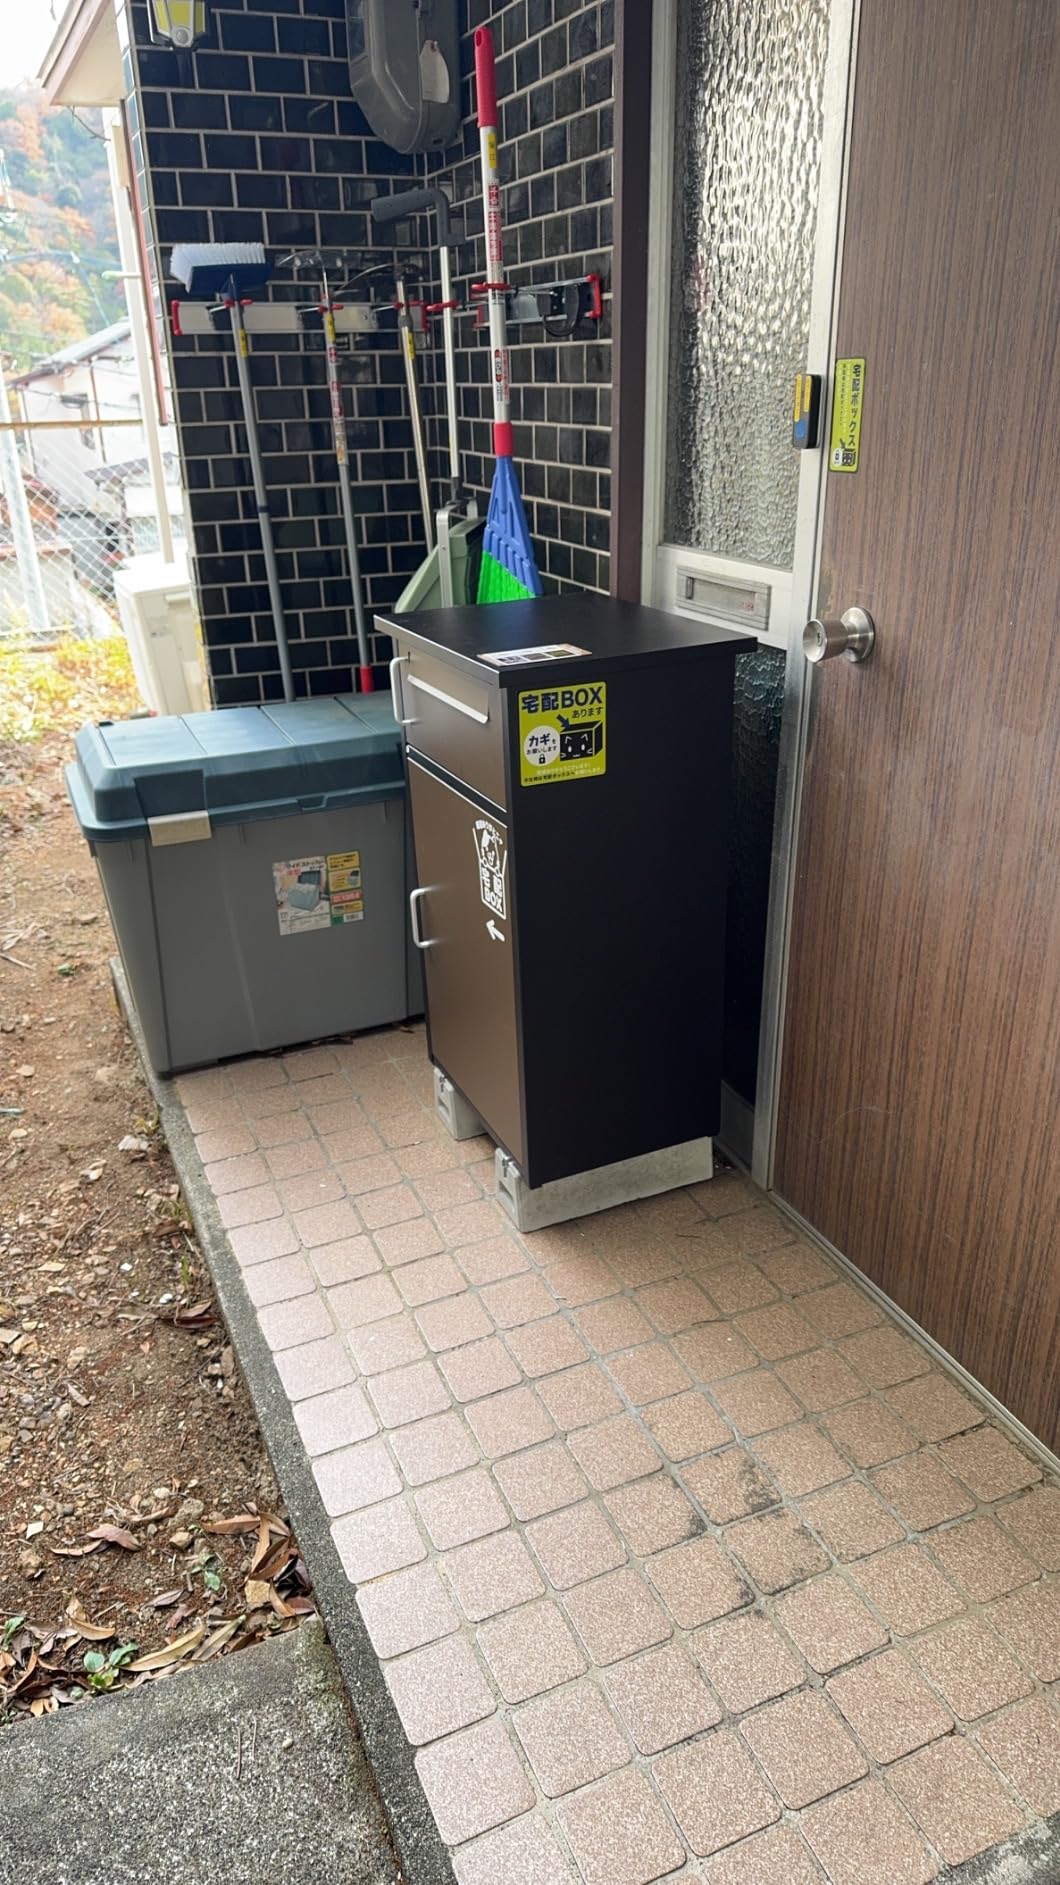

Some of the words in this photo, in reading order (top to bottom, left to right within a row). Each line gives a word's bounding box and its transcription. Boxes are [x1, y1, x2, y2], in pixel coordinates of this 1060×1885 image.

[848, 364, 862, 447] 宅配ボックス
[521, 686, 603, 714] 宅配BOX
[572, 706, 604, 719] あります
[484, 886, 503, 913] BOX
